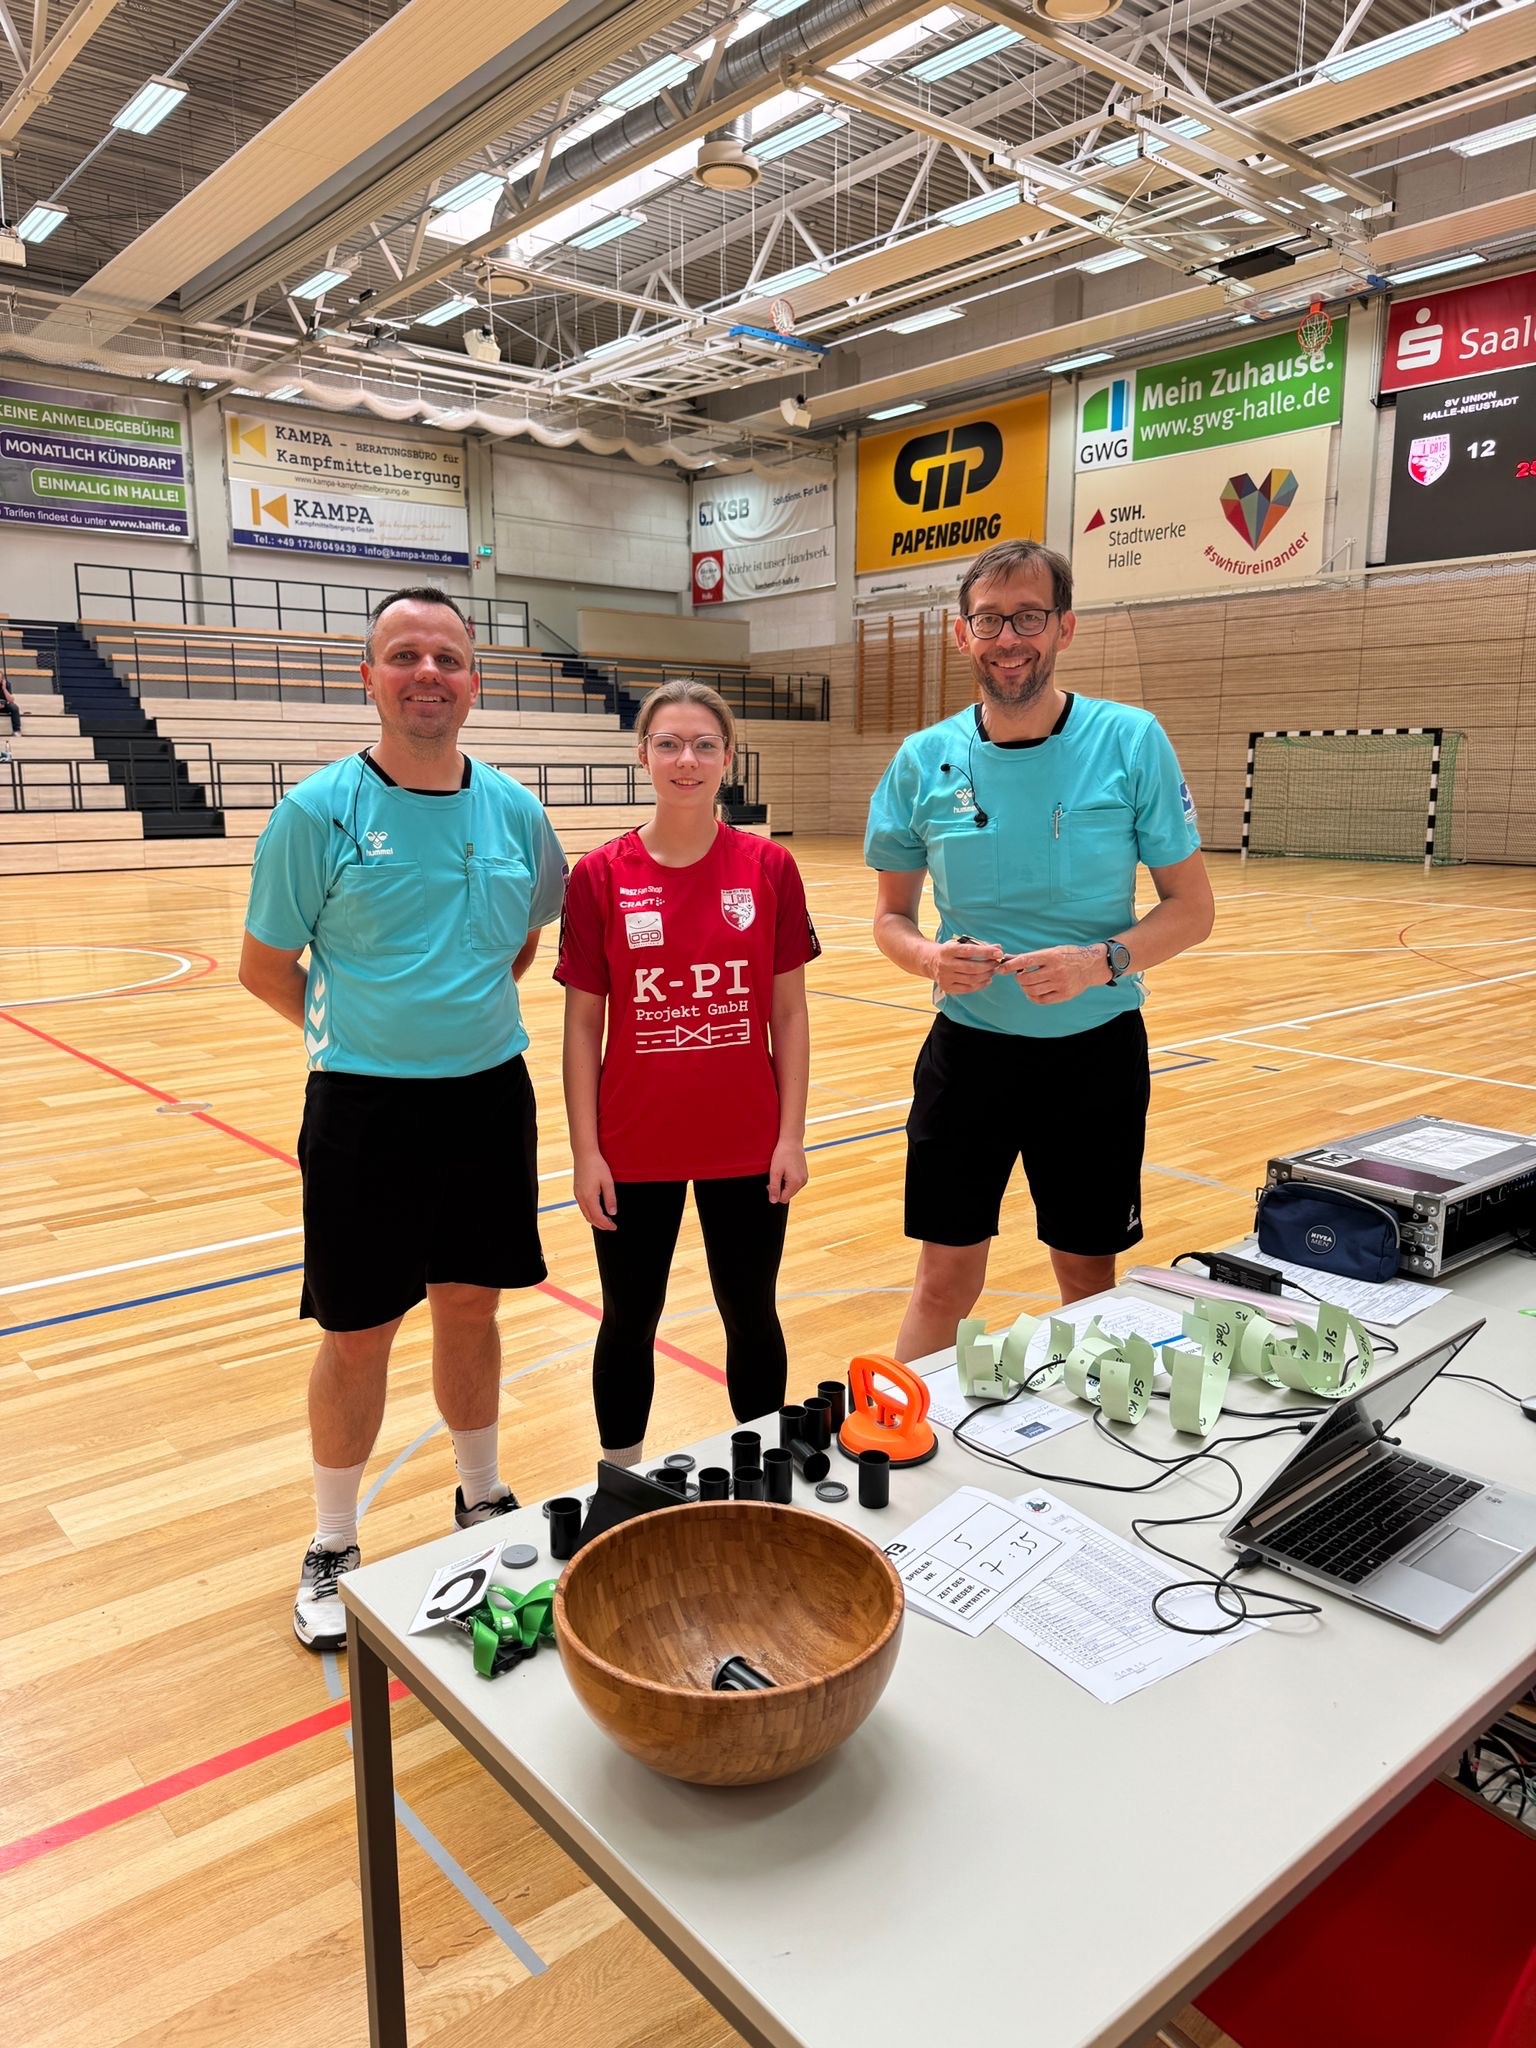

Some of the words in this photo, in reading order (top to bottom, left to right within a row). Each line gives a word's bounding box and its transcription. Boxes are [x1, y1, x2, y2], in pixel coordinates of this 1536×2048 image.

[1459, 314, 1536, 361] Saal
[1142, 376, 1203, 412] Mein
[1210, 351, 1334, 398] Zuhause.
[1140, 382, 1331, 442] www.gwg-halle.de
[1423, 396, 1519, 421] HALLE-NEUSTADT
[1444, 397, 1461, 408] SV
[1462, 391, 1497, 405] UNION
[42, 410, 175, 439] ANMELDEGEBÜHR!
[5, 439, 95, 462] MONATLICH
[275, 425, 333, 447] KAMPA
[356, 442, 438, 461] BERATUNGSBÜRO
[443, 453, 459, 464] für
[1080, 438, 1128, 464] GWG
[1467, 440, 1496, 459] 12
[276, 449, 461, 488] Kampfmittelbergung
[38, 476, 111, 496] EINMALIG
[113, 484, 129, 498] IN
[132, 487, 179, 503] HALLE!
[3, 506, 36, 519] Tarifen
[37, 510, 69, 523] findest
[70, 514, 83, 524] du
[84, 516, 108, 526] unter
[109, 518, 182, 532] www.halfit.de
[293, 498, 374, 525] KAMPA
[718, 497, 750, 522] KSB
[1109, 504, 1145, 523] SWH.
[891, 513, 1002, 556] PAPENBURG
[1108, 521, 1187, 548] Stadtwerke
[253, 534, 275, 545] Tel.:
[277, 537, 294, 547] +49
[298, 540, 357, 554] 173/6049439
[364, 546, 452, 563] info@kampa-kmb.de
[1107, 550, 1142, 569] Halle
[1203, 531, 1310, 576] #swhfüreinander
[366, 847, 394, 857] hummel
[619, 898, 656, 909] CRAFT
[633, 960, 750, 1003] K-PI
[636, 1004, 701, 1023] Projekt
[707, 1000, 749, 1016] GmbH
[1310, 1232, 1333, 1243] NIVEA
[1310, 1238, 1330, 1248] MEN
[953, 1533, 973, 1551] 5
[905, 1559, 933, 1582] SPIELER-
[923, 1572, 937, 1582] NR.
[937, 1585, 953, 1600] ZEIT
[952, 1576, 966, 1588] DES
[949, 1584, 975, 1605] WIEDER-
[957, 1587, 990, 1614] EINTRITTS
